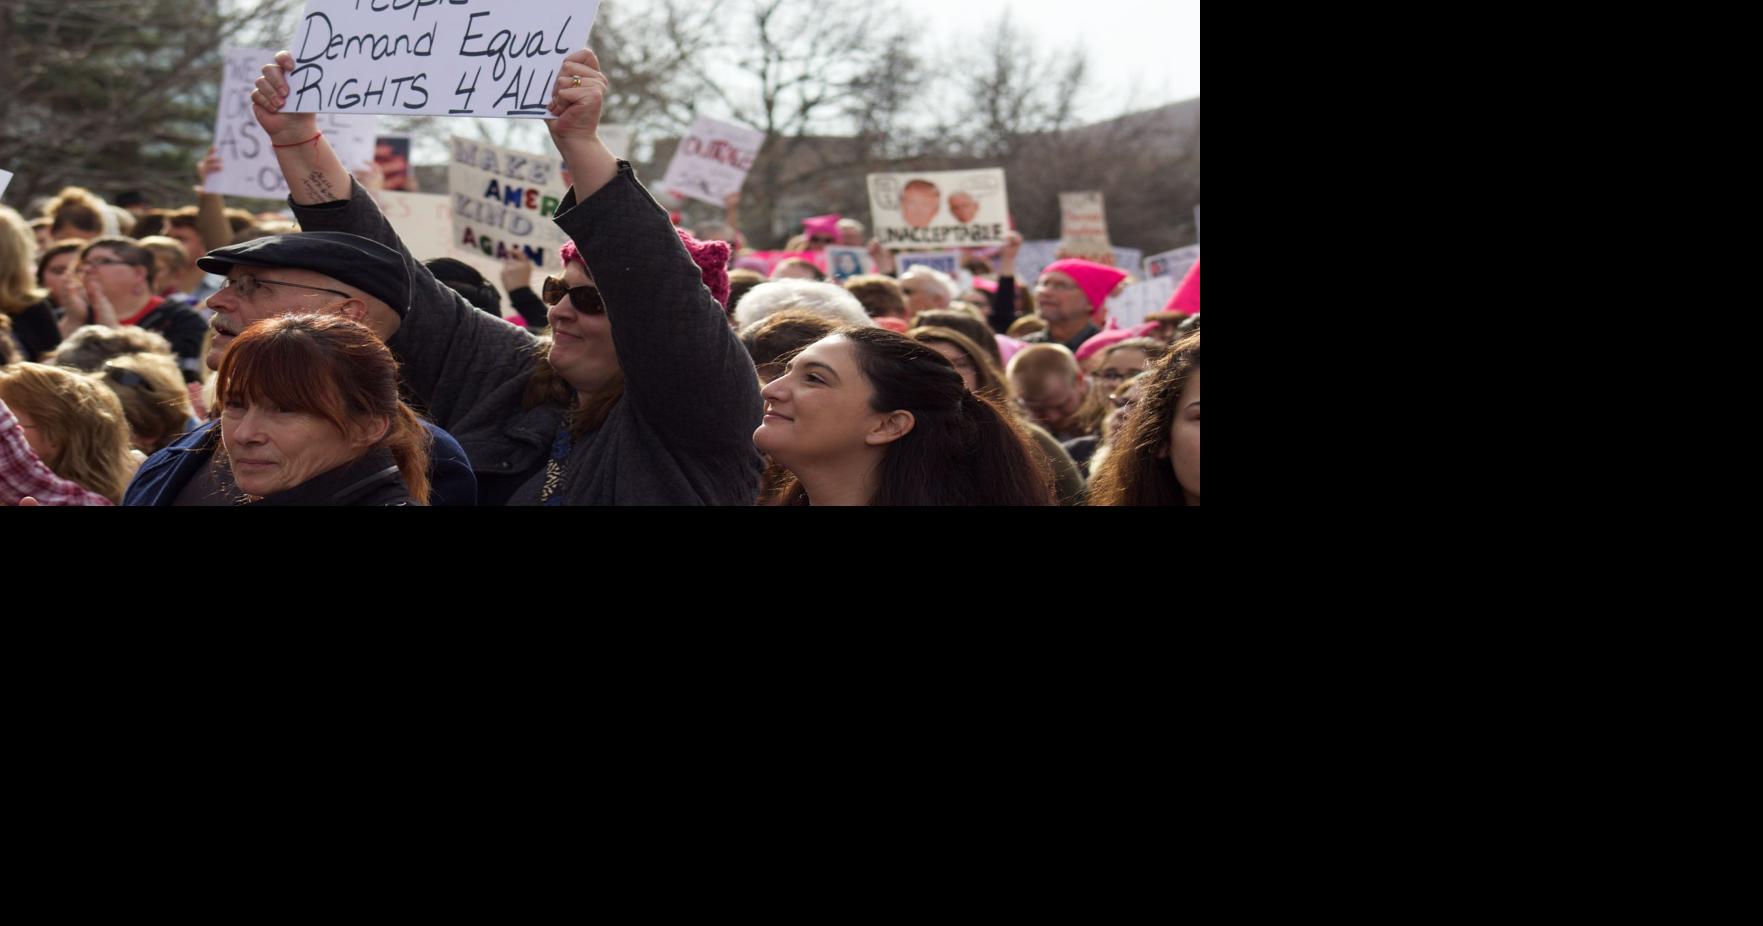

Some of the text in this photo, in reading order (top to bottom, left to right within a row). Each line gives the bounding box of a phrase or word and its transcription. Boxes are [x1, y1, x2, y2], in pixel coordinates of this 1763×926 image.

[296, 11, 572, 81] Demand Equal
[291, 63, 429, 111] RIGHTS
[448, 66, 482, 114] 4
[492, 65, 554, 115] ALL
[485, 179, 558, 217] AMER
